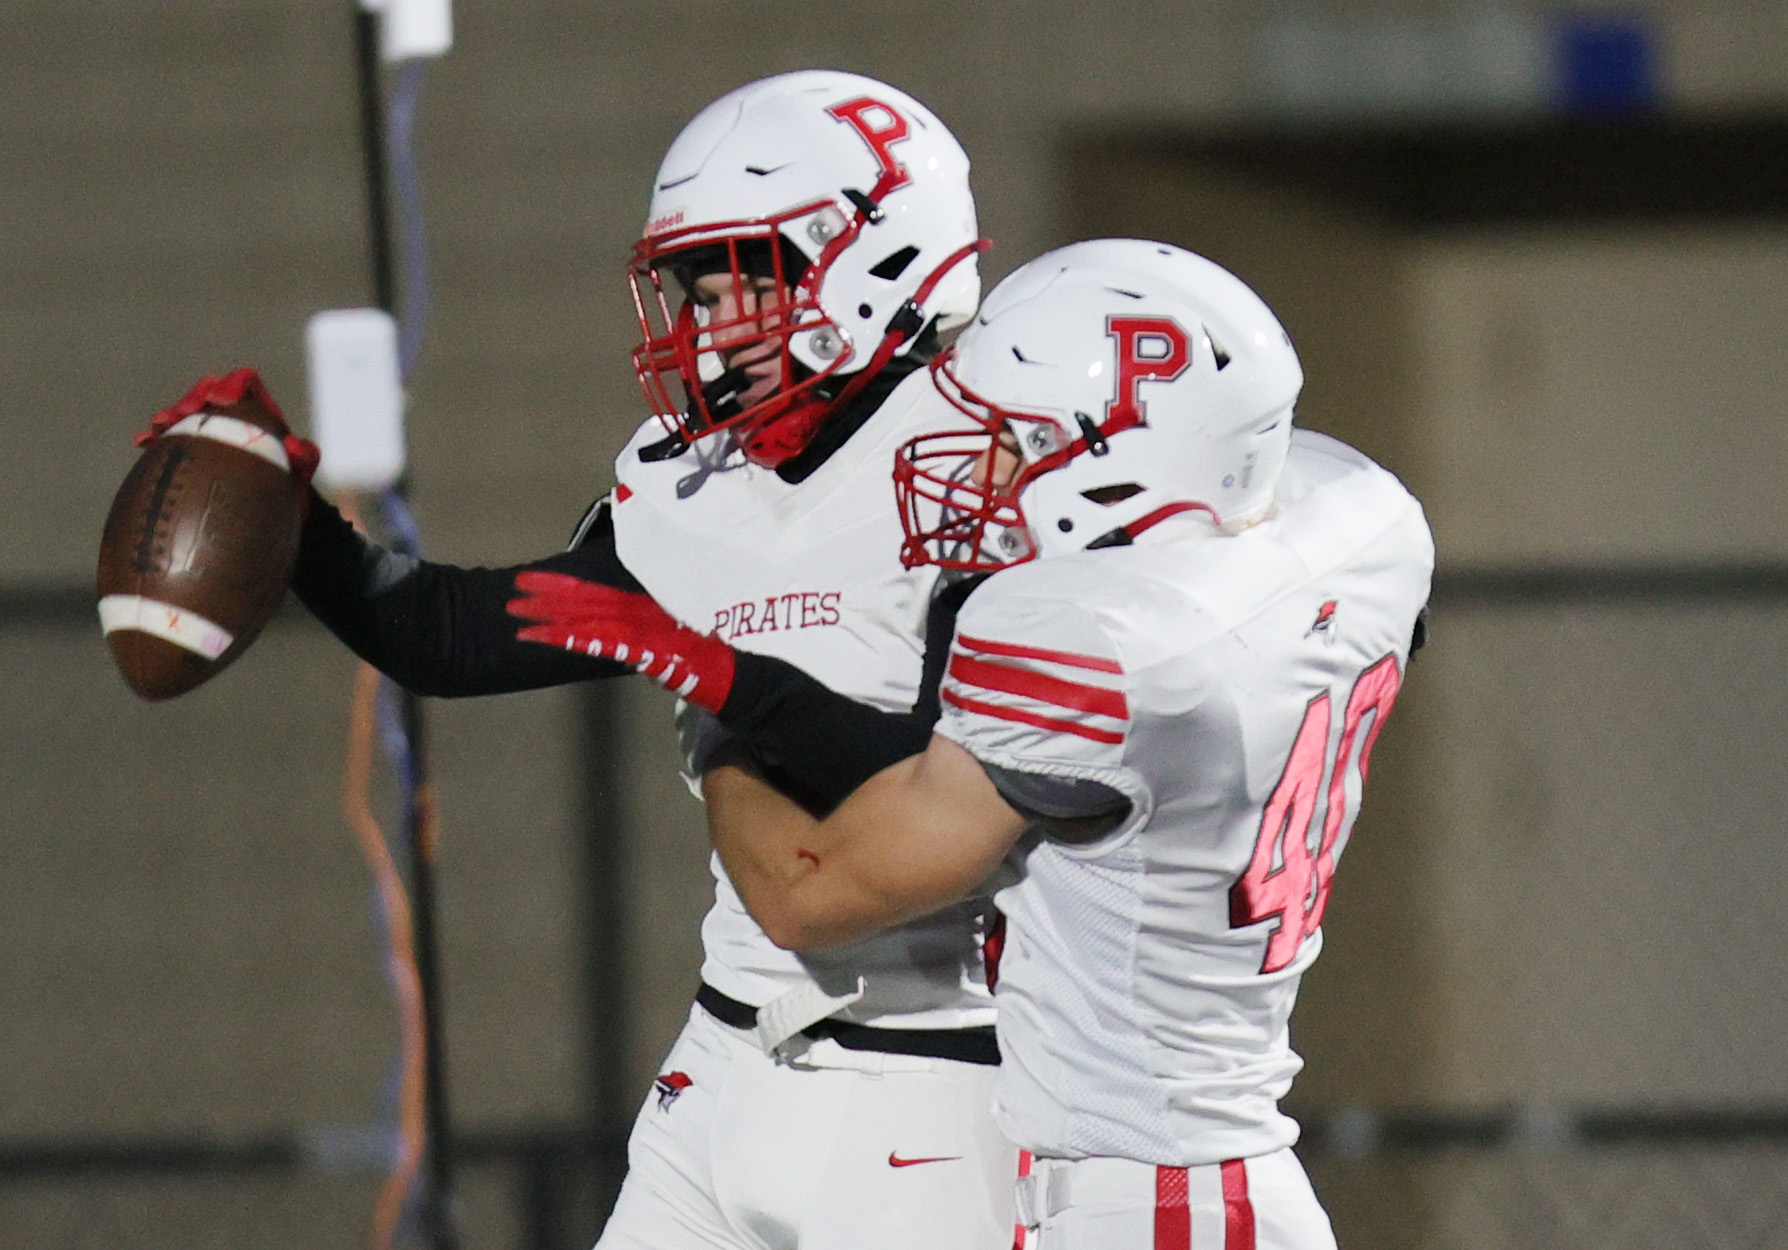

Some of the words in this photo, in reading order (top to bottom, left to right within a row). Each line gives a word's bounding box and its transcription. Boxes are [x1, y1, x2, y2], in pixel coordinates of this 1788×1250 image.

[823, 96, 913, 198] P
[1105, 314, 1192, 428] P
[710, 591, 841, 641] PIRATES
[1229, 650, 1402, 975] 40
